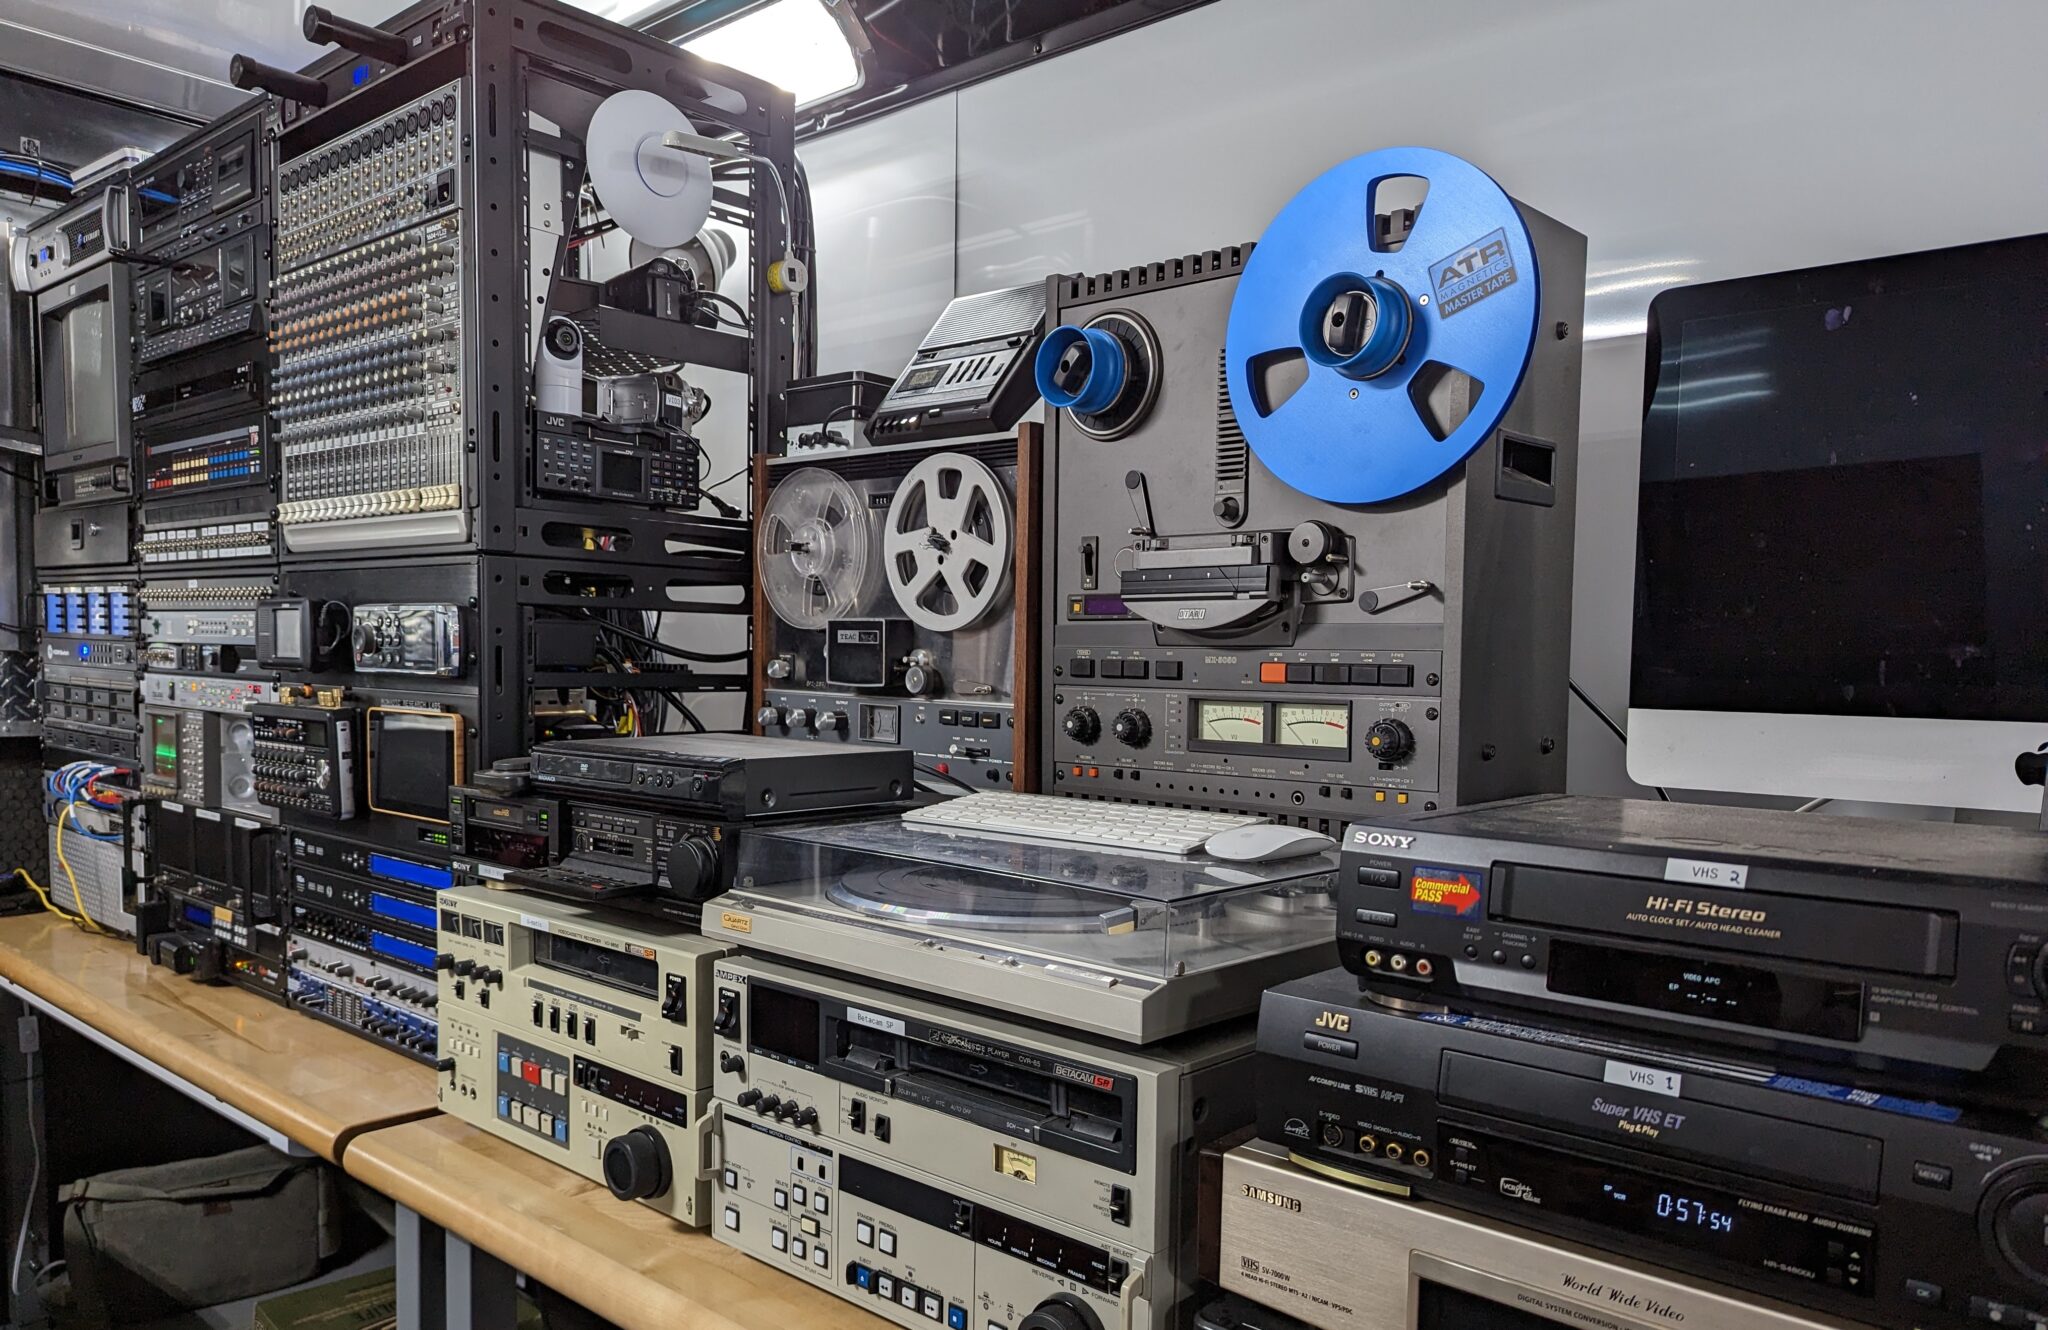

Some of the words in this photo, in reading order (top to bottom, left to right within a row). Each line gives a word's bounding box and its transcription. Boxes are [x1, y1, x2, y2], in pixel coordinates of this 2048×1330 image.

[1438, 240, 1505, 290] ATR
[1440, 260, 1510, 300] MAGNETICS
[1444, 286, 1484, 314] MASTER
[1485, 272, 1512, 294] TAPE
[546, 416, 564, 427] JVC
[1177, 608, 1206, 620] OTARI
[840, 632, 857, 640] TEAC
[1204, 656, 1237, 664] MX-5050
[1354, 831, 1416, 849] SONY
[453, 861, 472, 872] SONY
[1369, 859, 1392, 868] POWER
[1692, 866, 1719, 880] VHS
[1730, 870, 1740, 884] 2
[1415, 878, 1470, 895] Commercial
[1414, 890, 1444, 903] PASS
[1646, 896, 1694, 914] Hi-Fi
[1696, 902, 1766, 924] Stereo
[1626, 912, 1648, 923] AUTO
[1649, 914, 1674, 926] CLOCK
[1720, 923, 1742, 935] HEAD
[1744, 926, 1782, 940] CLEANER
[1368, 935, 1385, 944] VIDEO
[715, 969, 747, 984] AMPEX
[722, 990, 735, 998] POWER
[1668, 982, 1680, 992] EP
[858, 1013, 883, 1027] Betacam
[886, 1021, 894, 1030] SP
[1316, 1011, 1350, 1032] JVC
[988, 1046, 1010, 1058] PLAYER
[1318, 1041, 1341, 1052] POWER
[1055, 1066, 1094, 1084] BETACAM
[1096, 1076, 1110, 1088] SP
[1630, 1070, 1654, 1086] VHS
[1666, 1076, 1674, 1090] 1
[856, 1092, 868, 1100] AUDIO
[869, 1096, 888, 1106] MONITOR
[951, 1104, 962, 1112] AUTO
[1592, 1097, 1630, 1118] Super
[1632, 1106, 1662, 1125] VHS
[1664, 1114, 1686, 1130] ET
[1356, 1120, 1372, 1129] VIDEO
[769, 1129, 784, 1138] MOTION
[785, 1134, 803, 1145] CONTROL
[1918, 1168, 1944, 1182] MENU
[1094, 1178, 1110, 1189] REMOTE
[1242, 1183, 1302, 1212] SAMSUNG
[805, 1208, 817, 1217] ENTRY
[1093, 1204, 1110, 1214] REMOTE
[1657, 1193, 1733, 1232] 0:57:54
[857, 1212, 875, 1222] STANDBY
[1738, 1198, 1763, 1212] FLYING
[1763, 1204, 1787, 1218] ERASE
[1788, 1209, 1809, 1222] HEAD
[1812, 1216, 1836, 1229] AUDIO
[1837, 1222, 1872, 1238] DUBBING
[879, 1220, 897, 1232] PREROLL
[859, 1256, 871, 1264] EJECT
[988, 1237, 1002, 1247] HOURS
[1010, 1246, 1029, 1258] MINUTES
[1036, 1256, 1057, 1269] SECONDS
[1068, 1269, 1086, 1280] FRAMES
[1112, 1247, 1134, 1259] SELECT
[1092, 1262, 1106, 1271] RESET
[1241, 1256, 1259, 1273] VHS
[1032, 1268, 1055, 1282] REVERSE
[1245, 1273, 1258, 1281] HEAD
[1270, 1280, 1288, 1292] STEREO
[952, 1296, 964, 1304] STOP
[1091, 1292, 1119, 1308] FORWARD
[1561, 1272, 1603, 1297] World
[1607, 1287, 1642, 1309] Wide
[1644, 1300, 1686, 1322] Video
[1916, 1288, 1930, 1298] OK
[1517, 1293, 1544, 1308] DIGITAL
[1544, 1302, 1572, 1317] SYSTEM
[1573, 1310, 1618, 1330] CONVERSION
